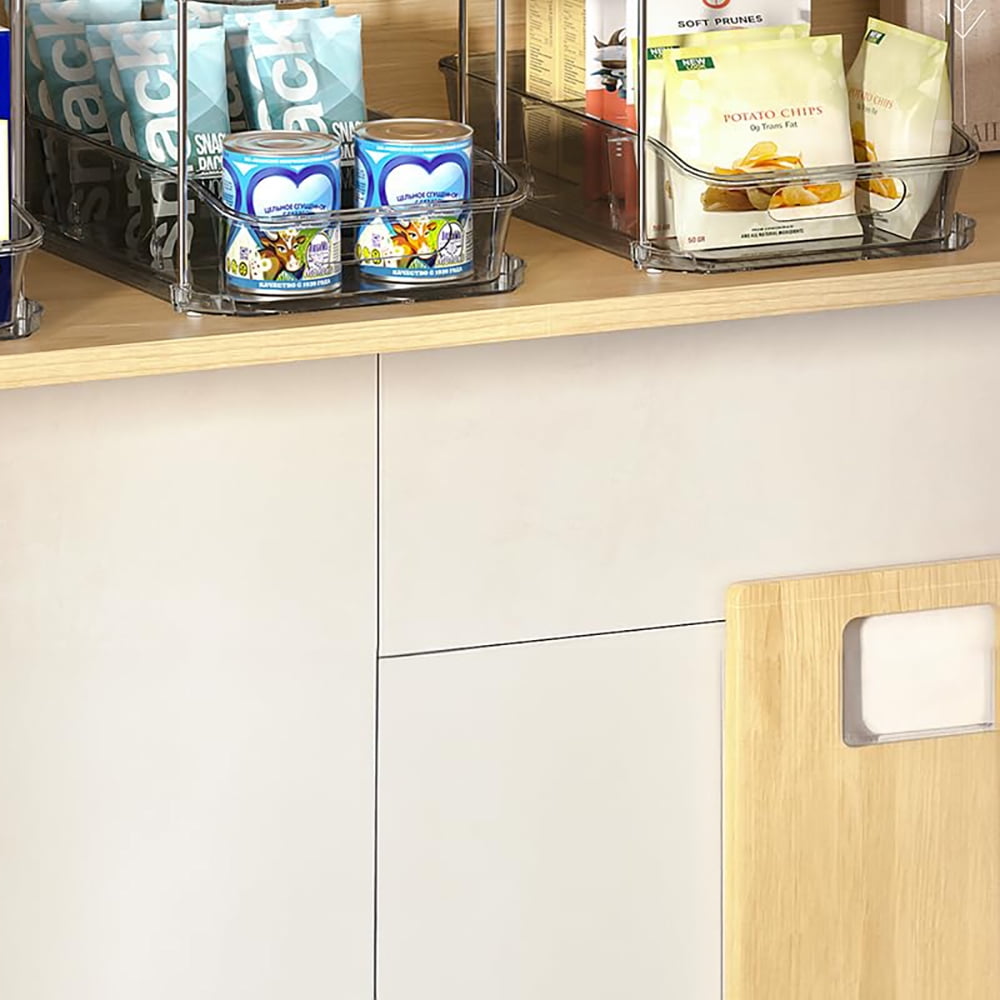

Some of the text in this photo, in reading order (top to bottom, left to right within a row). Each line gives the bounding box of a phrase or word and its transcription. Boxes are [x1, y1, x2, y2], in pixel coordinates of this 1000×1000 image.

[678, 14, 764, 29] SOFT PRUNES
[682, 58, 706, 66] NEW
[723, 105, 824, 123] POTATO CHIPS
[785, 120, 798, 129] Fat
[194, 132, 226, 156] SNAC
